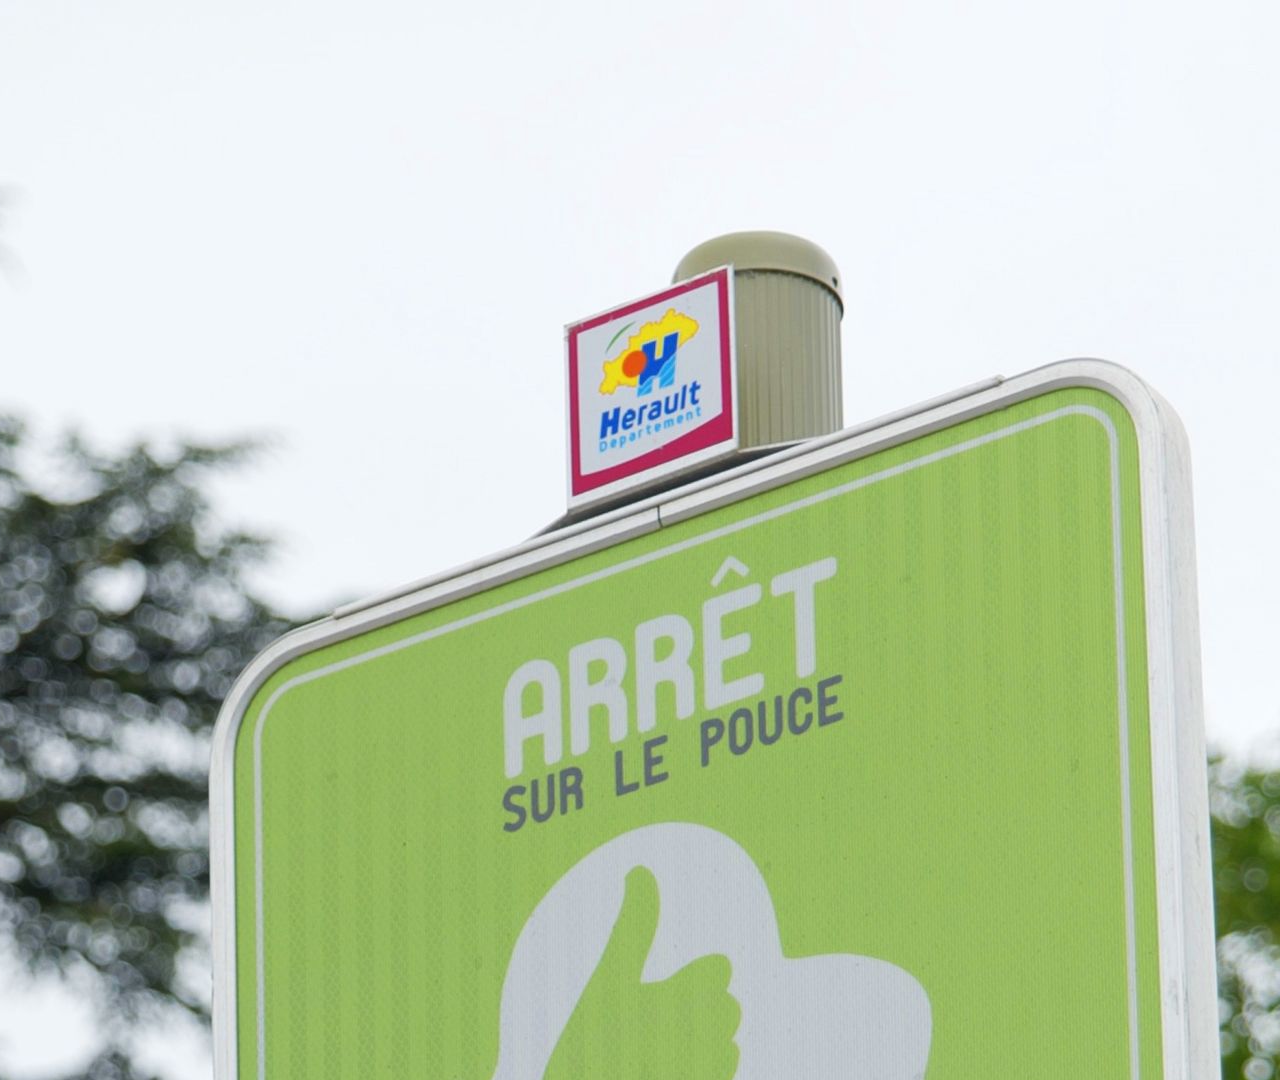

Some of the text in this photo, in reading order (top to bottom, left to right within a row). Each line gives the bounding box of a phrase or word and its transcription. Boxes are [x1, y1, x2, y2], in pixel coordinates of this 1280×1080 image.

[599, 380, 701, 440] Herault
[599, 406, 702, 453] Departement
[503, 555, 838, 779] ARRÊT
[502, 674, 845, 833] SUR LE POUCE
